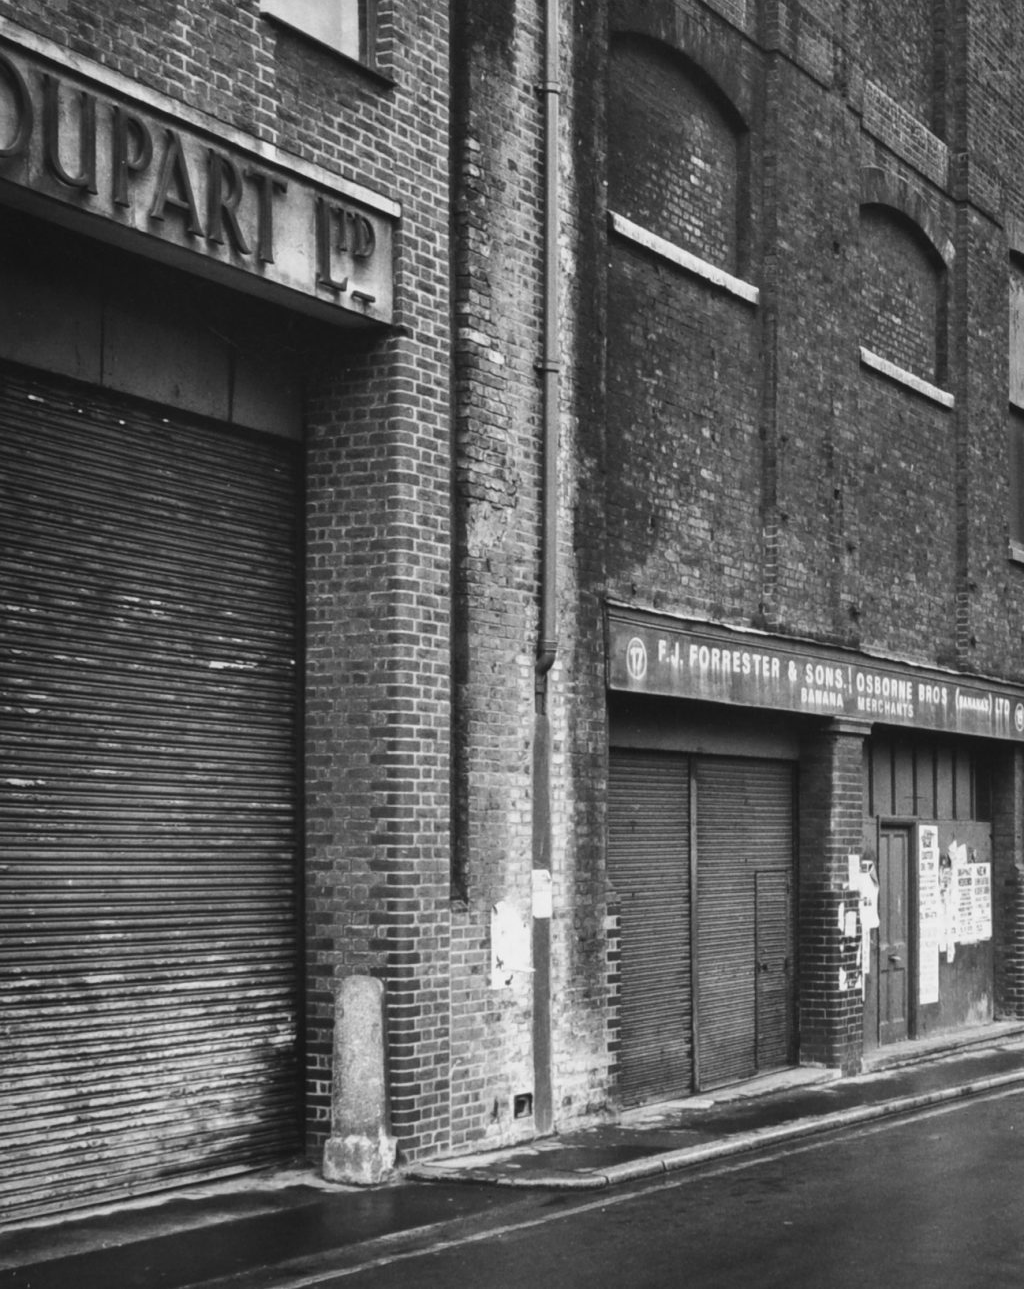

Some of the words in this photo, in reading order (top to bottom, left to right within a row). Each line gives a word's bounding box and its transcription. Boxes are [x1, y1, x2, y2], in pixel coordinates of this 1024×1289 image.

[657, 638, 684, 670] F.J.
[688, 644, 780, 678] FORRESTER
[787, 660, 798, 682] &
[800, 687, 844, 708] BANANA
[857, 696, 914, 718] MERCHANTS
[855, 672, 913, 700] OSBORNE
[918, 683, 947, 706] BROS
[995, 696, 1010, 715] LTD
